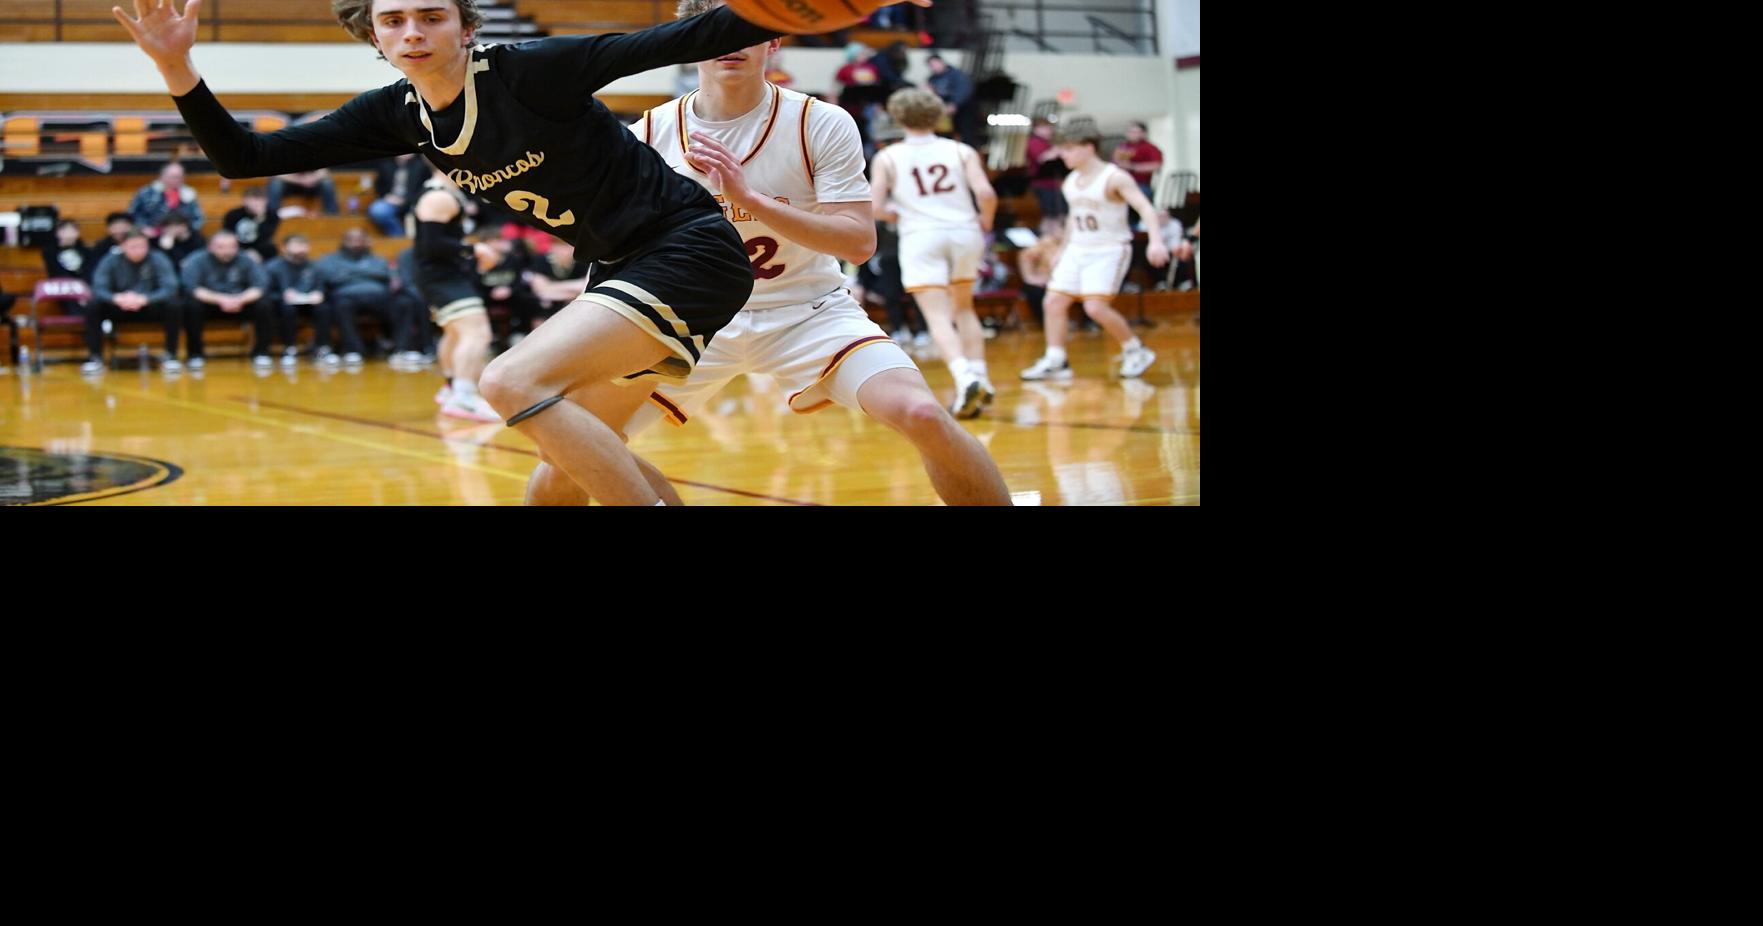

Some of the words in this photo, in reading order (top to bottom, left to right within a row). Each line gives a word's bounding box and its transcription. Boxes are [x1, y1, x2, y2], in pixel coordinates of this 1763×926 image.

[447, 151, 545, 195] Broncos
[911, 163, 956, 196] 12
[504, 190, 575, 228] 2
